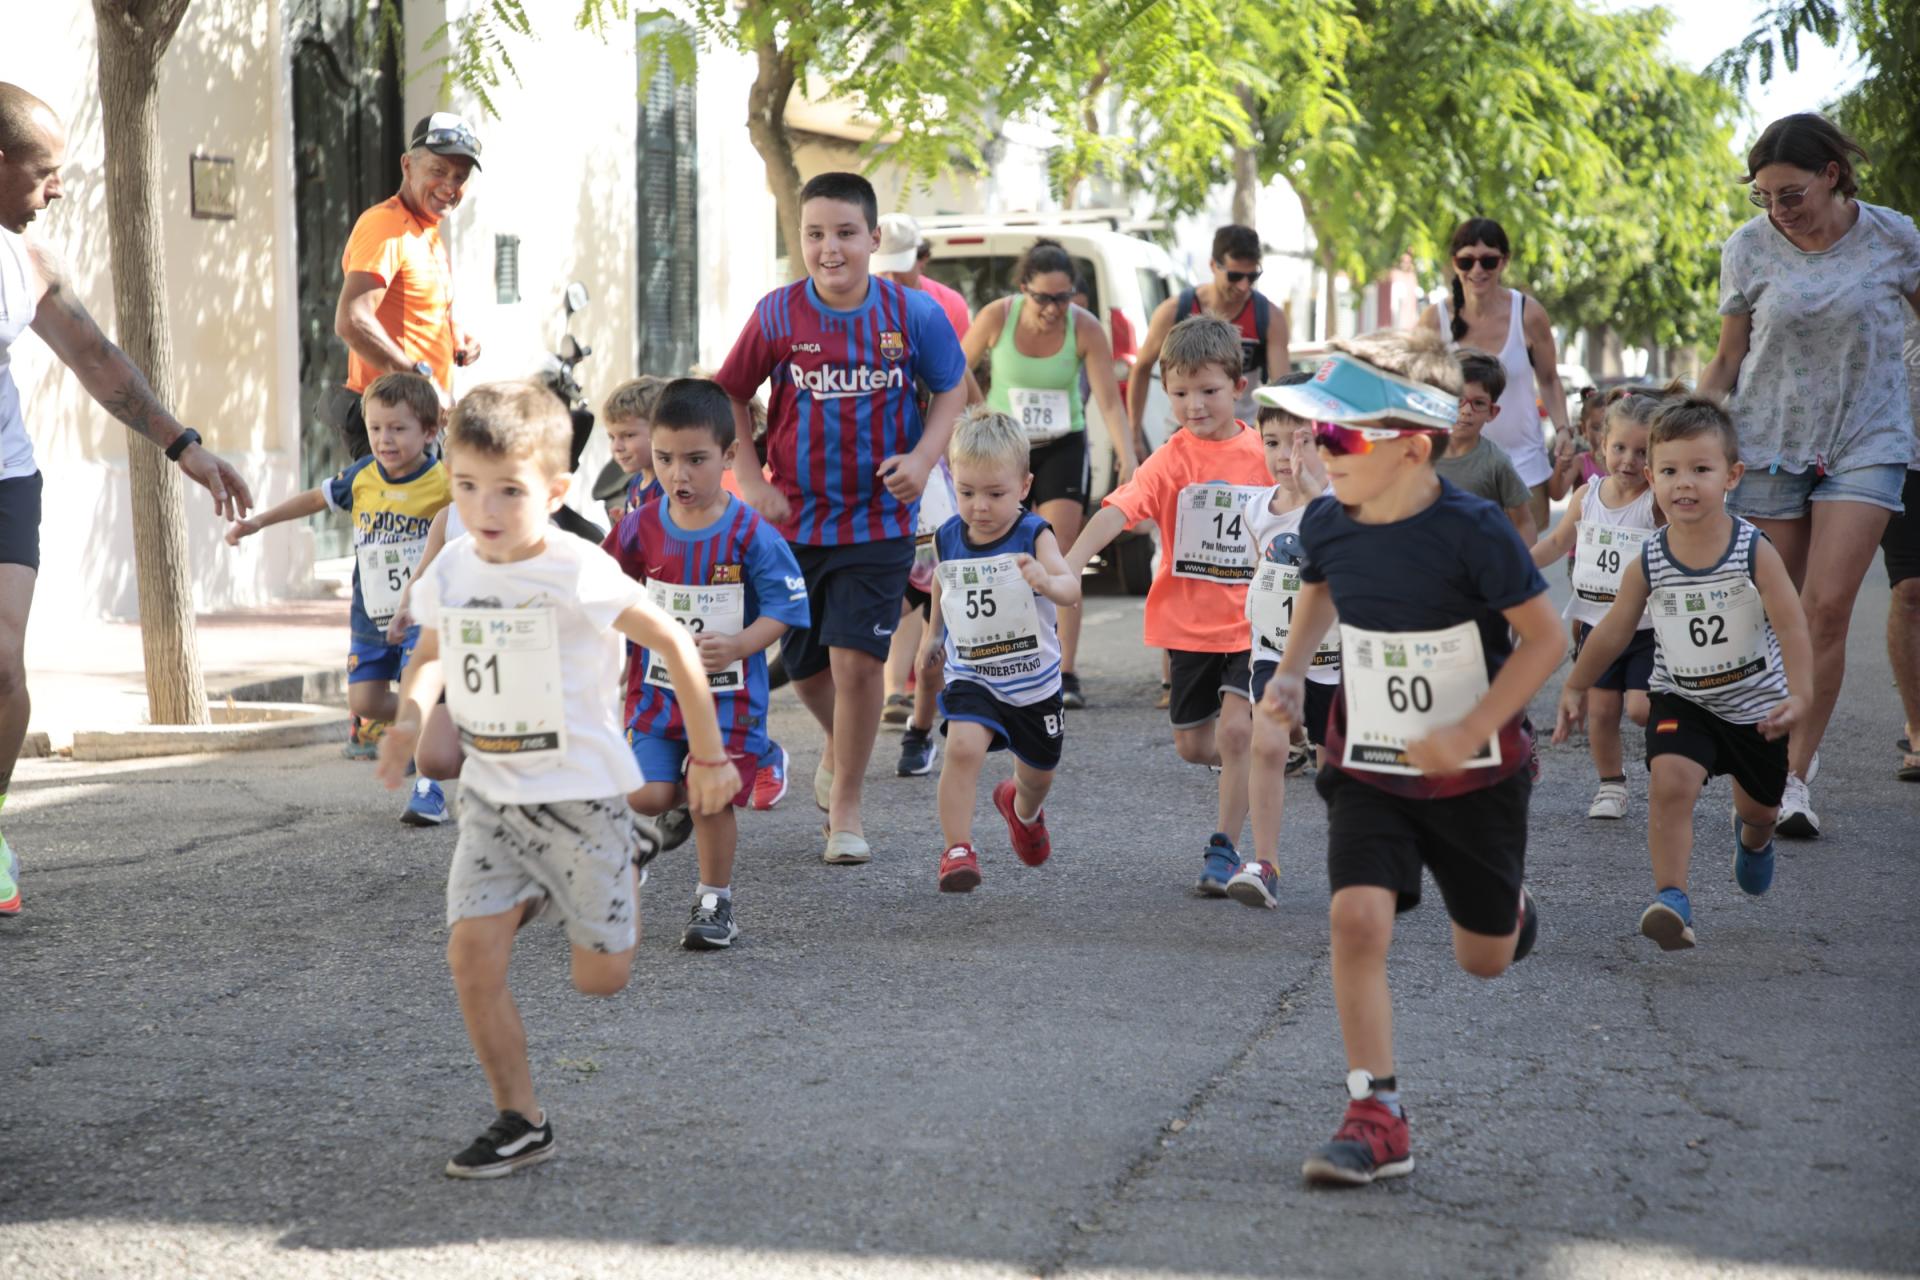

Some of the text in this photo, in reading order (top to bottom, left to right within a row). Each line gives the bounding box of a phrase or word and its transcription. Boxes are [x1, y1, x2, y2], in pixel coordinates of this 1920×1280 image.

[791, 343, 821, 354] BARÇA
[790, 363, 903, 392] Rakuten
[1023, 407, 1053, 425] 878
[1213, 512, 1242, 541] 14
[1202, 540, 1214, 550] Pau
[1597, 549, 1620, 574] 49
[966, 589, 996, 619] 55
[1689, 615, 1728, 647] 62
[464, 653, 500, 695] 61
[975, 658, 1041, 677] UNDERSTAND
[1387, 675, 1433, 713] 60
